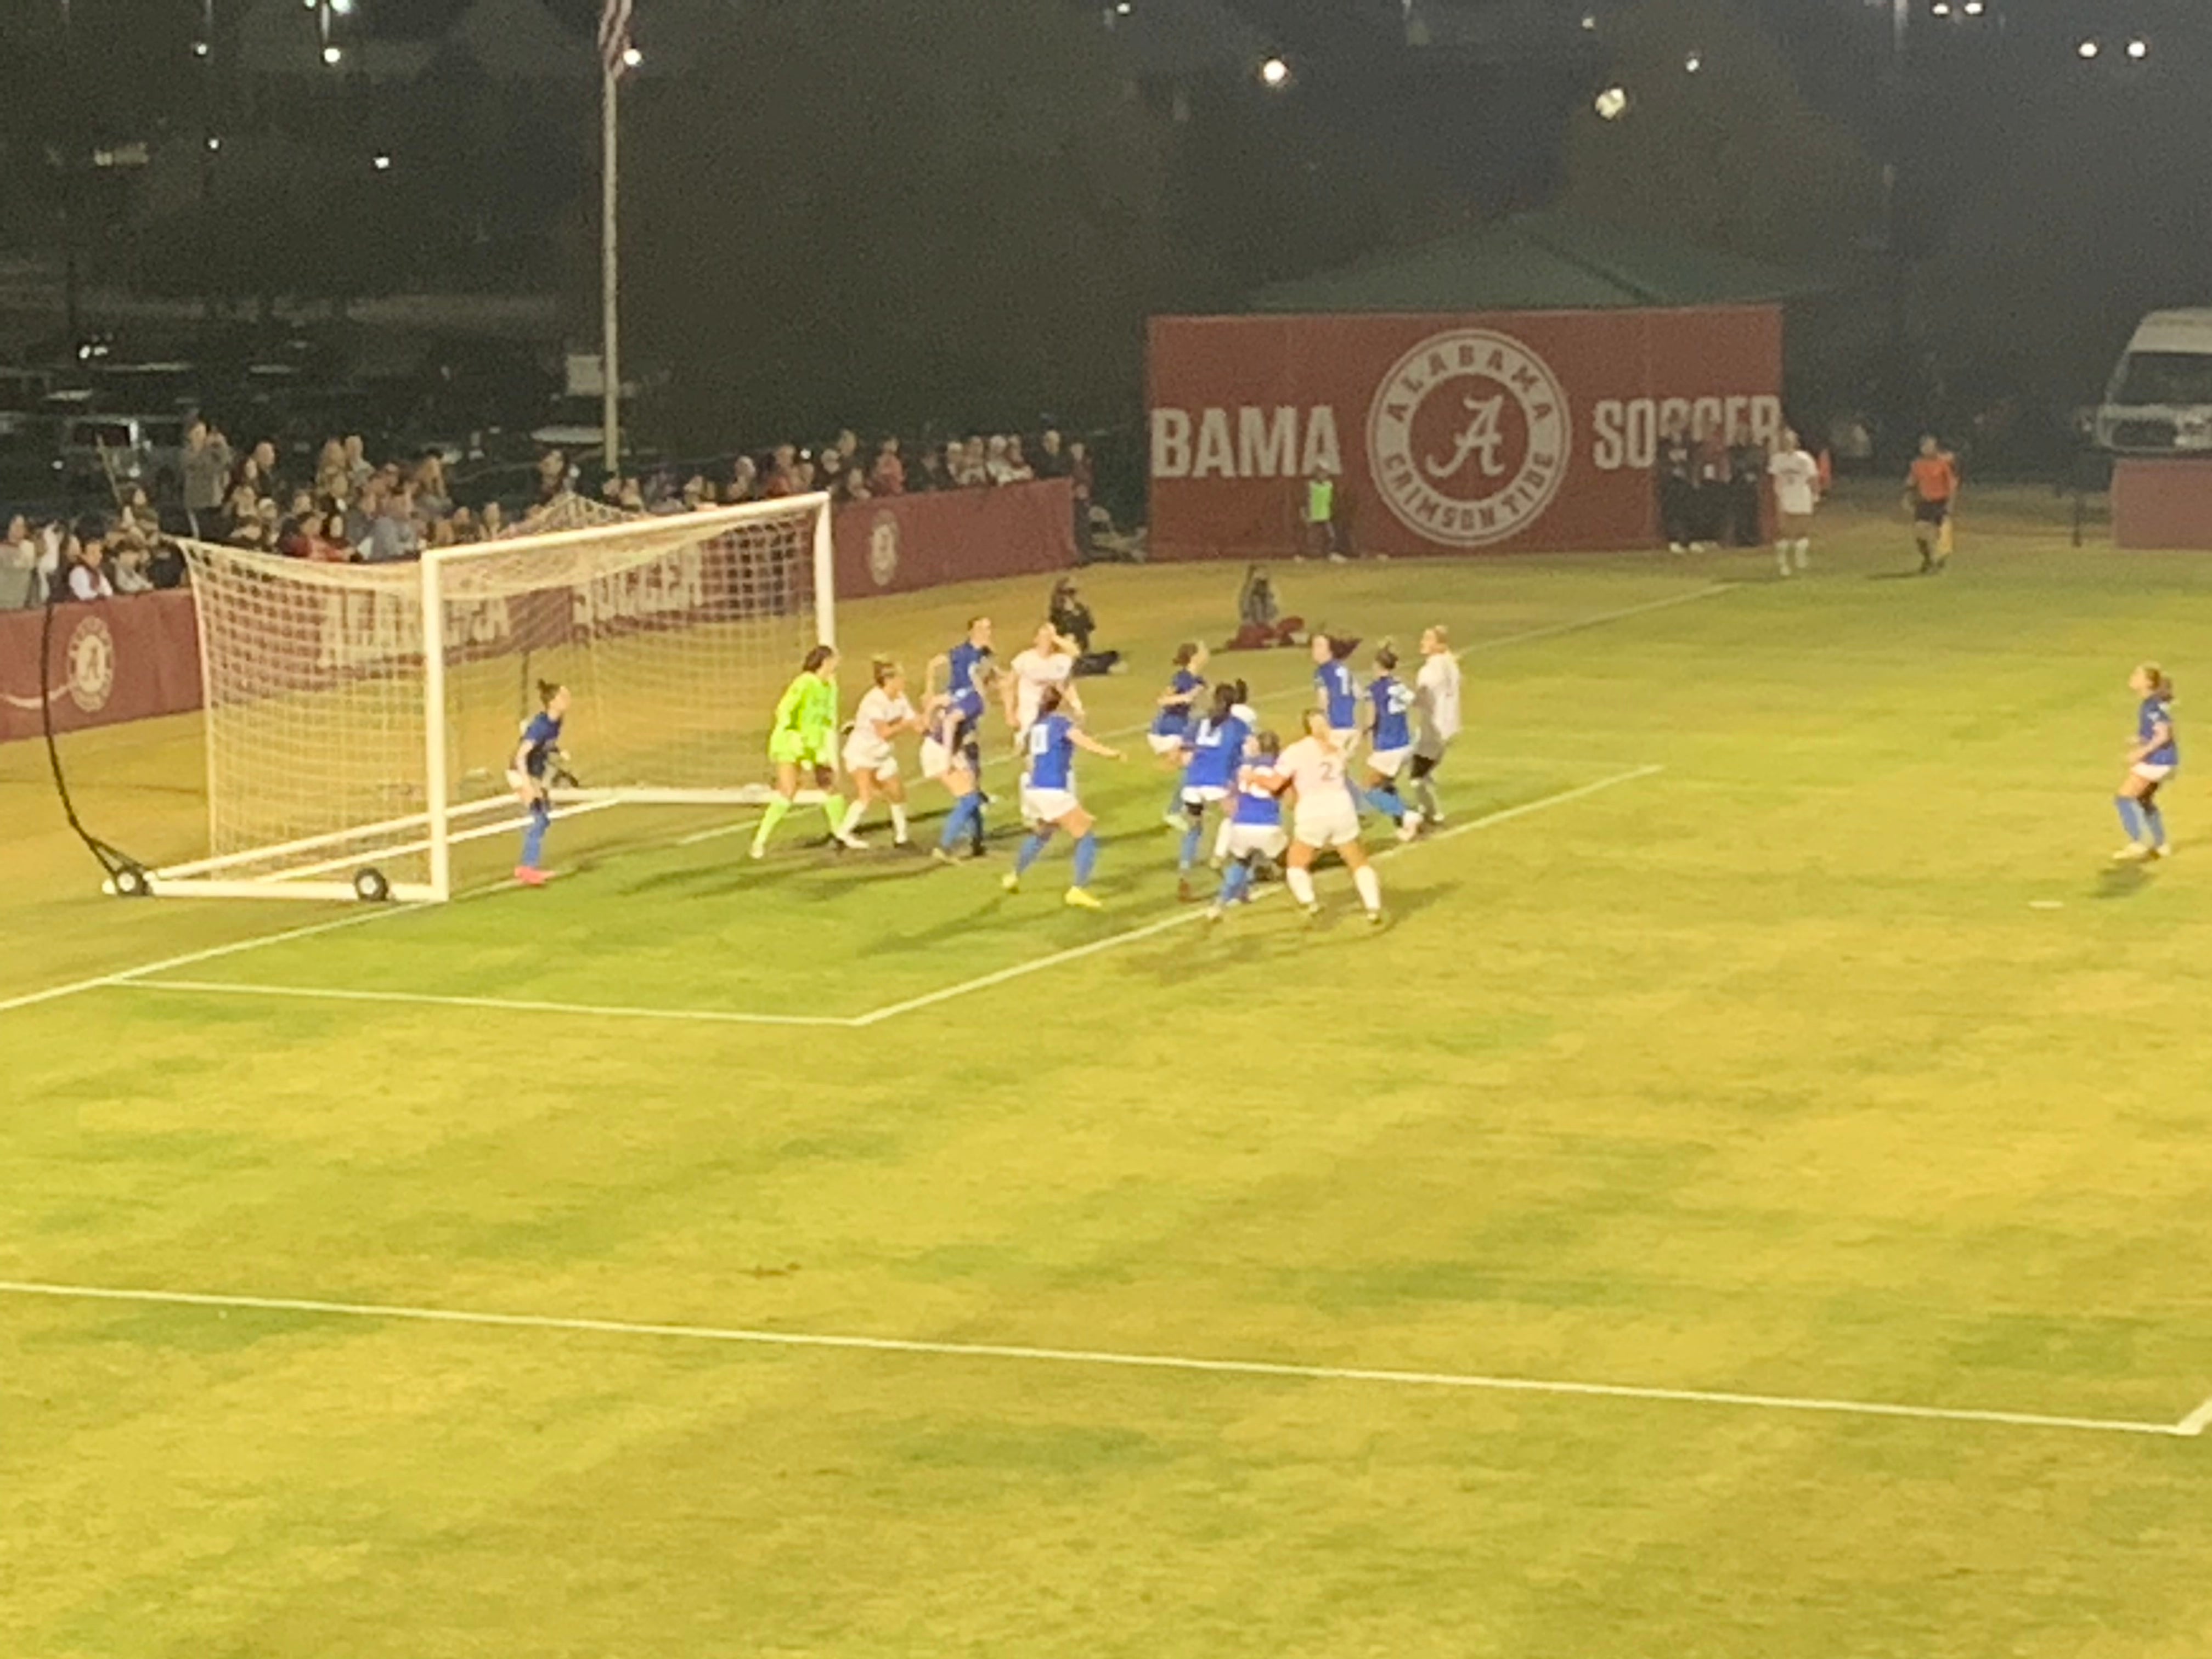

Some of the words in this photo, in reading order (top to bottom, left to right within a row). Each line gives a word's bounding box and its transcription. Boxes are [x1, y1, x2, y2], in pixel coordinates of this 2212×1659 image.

[1386, 343, 1552, 423] ALABAMA
[1151, 405, 1341, 478] BAMA
[1384, 453, 1496, 531] CRIMSON
[1501, 452, 1554, 515] TIDE
